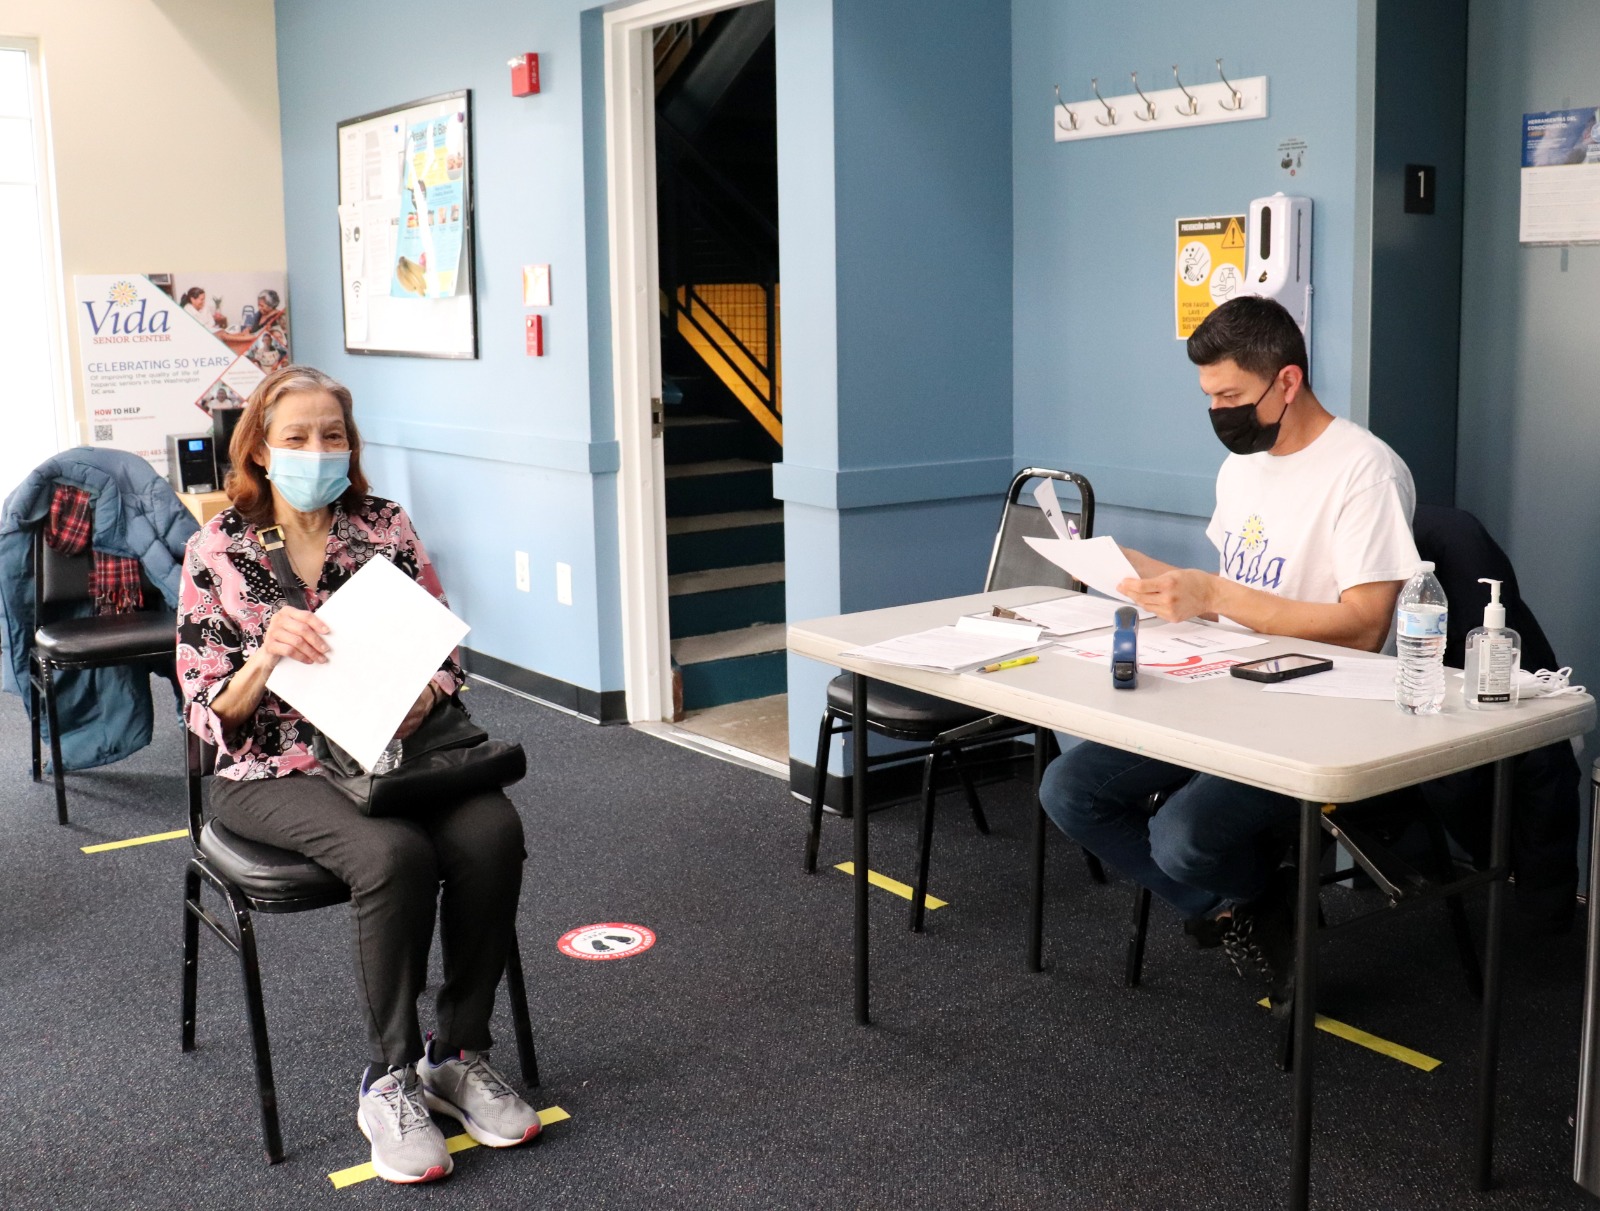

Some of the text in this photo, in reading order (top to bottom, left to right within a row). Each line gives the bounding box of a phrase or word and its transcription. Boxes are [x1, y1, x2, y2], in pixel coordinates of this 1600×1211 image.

[1418, 170, 1425, 198] 1
[82, 298, 171, 335] Vida
[93, 334, 171, 344] SENIOR CENTER
[88, 356, 230, 373] CELEBRATING 50 YEARS
[1224, 531, 1287, 589] Vida
[562, 945, 610, 959] DISTANCE
